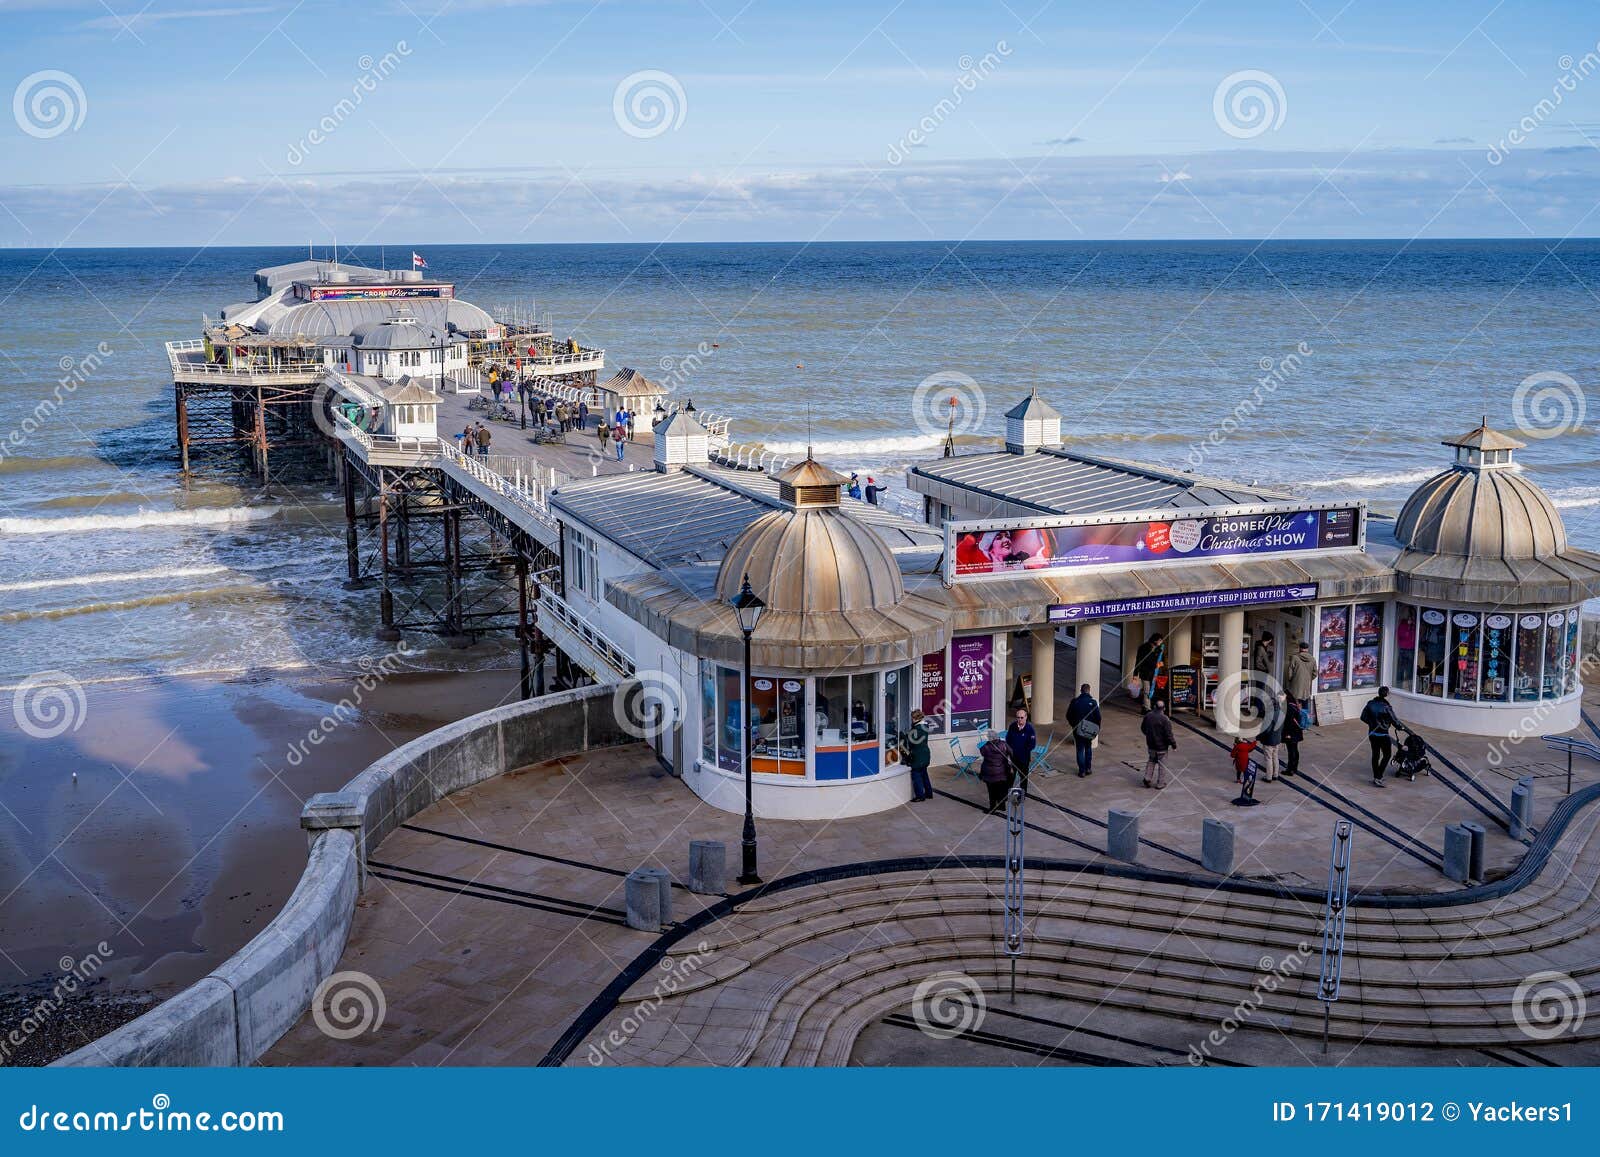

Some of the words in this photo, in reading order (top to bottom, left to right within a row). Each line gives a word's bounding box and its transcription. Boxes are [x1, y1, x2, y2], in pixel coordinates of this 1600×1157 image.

[1213, 520, 1265, 533] CROMER
[1263, 515, 1296, 533] Pier
[1200, 535, 1263, 551] Christmas
[1265, 533, 1306, 546] SHOW
[1084, 607, 1101, 615] BAR
[1106, 602, 1142, 613] THEATRE
[1145, 597, 1196, 609] RESTAURANT
[1199, 595, 1217, 604] GIFT
[1218, 594, 1239, 602] SHOP
[1243, 591, 1258, 599] BOX
[1260, 589, 1285, 599] OFFICE
[958, 660, 984, 669] OPEN
[959, 674, 984, 682] YEAR
